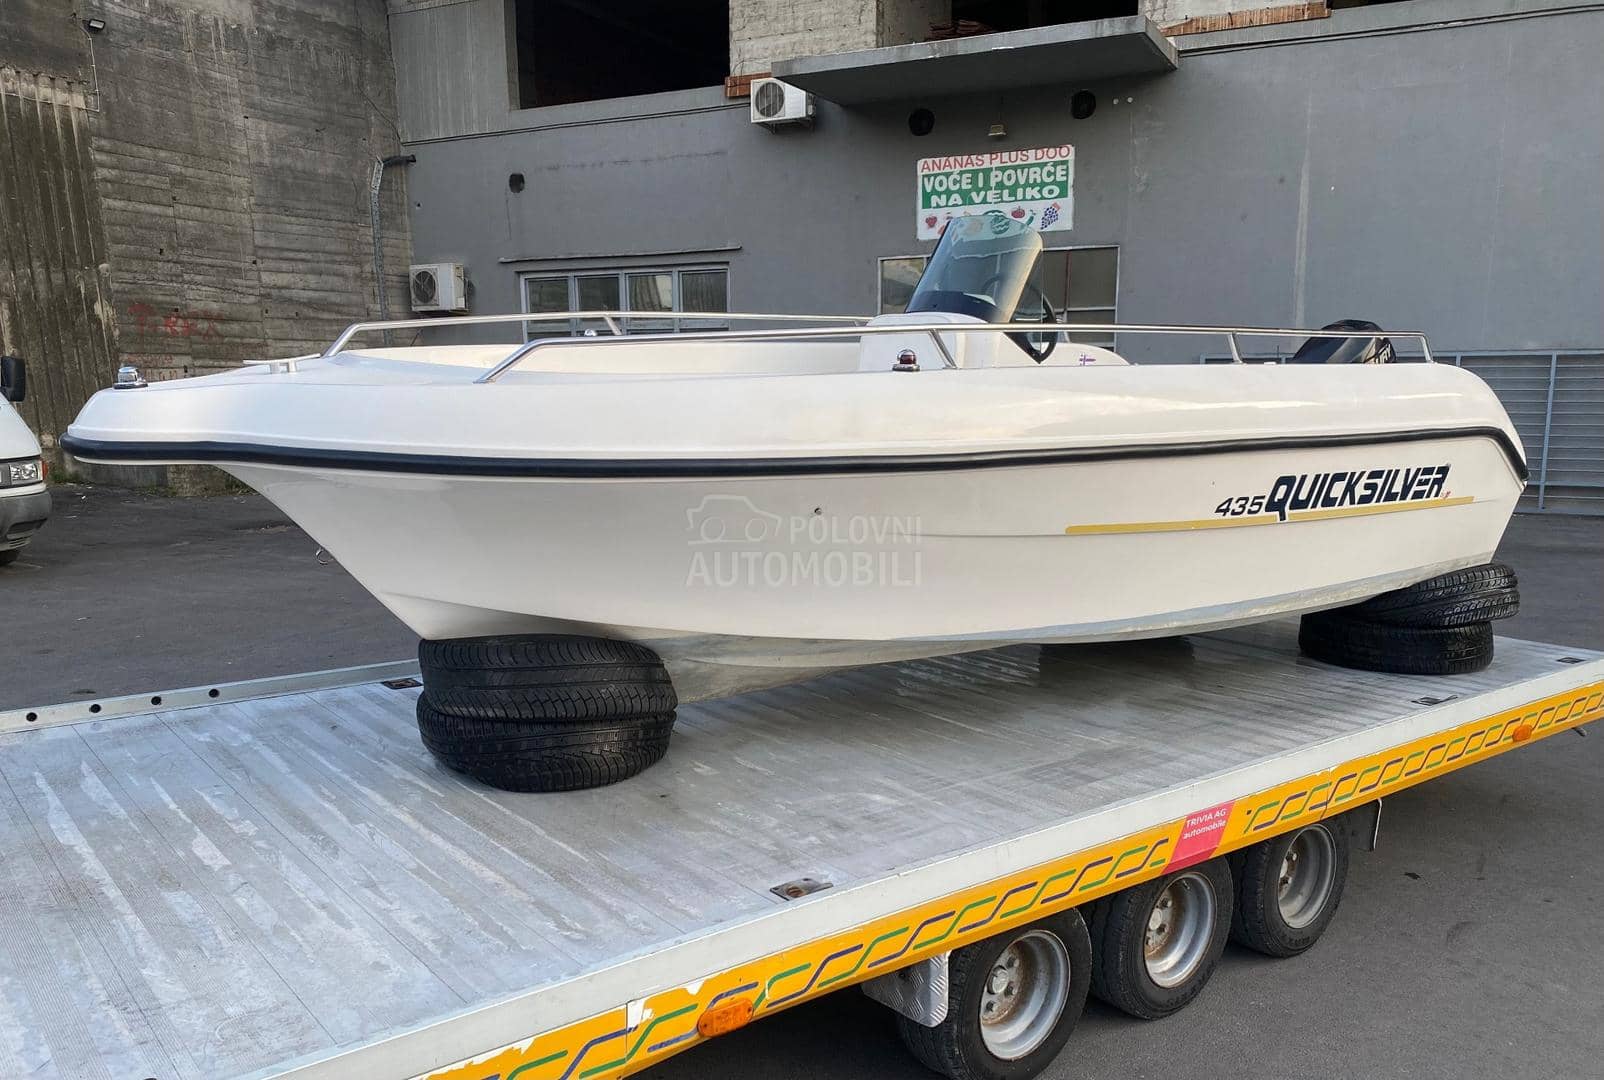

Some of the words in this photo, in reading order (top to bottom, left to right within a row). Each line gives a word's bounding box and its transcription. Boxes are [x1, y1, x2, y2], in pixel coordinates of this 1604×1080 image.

[921, 155, 984, 172] ANANAS
[990, 149, 1029, 165] PLUS
[1034, 145, 1070, 159] DOO
[924, 170, 972, 193] VOĆE
[978, 172, 984, 188] I
[931, 193, 962, 208] NA
[971, 185, 1060, 204] VELIKO
[1214, 495, 1266, 516] 435
[1265, 464, 1451, 522] QUICKSILVER
[1186, 813, 1212, 827] TRIVIA
[1214, 808, 1227, 818] AG
[1183, 820, 1226, 839] automobile
